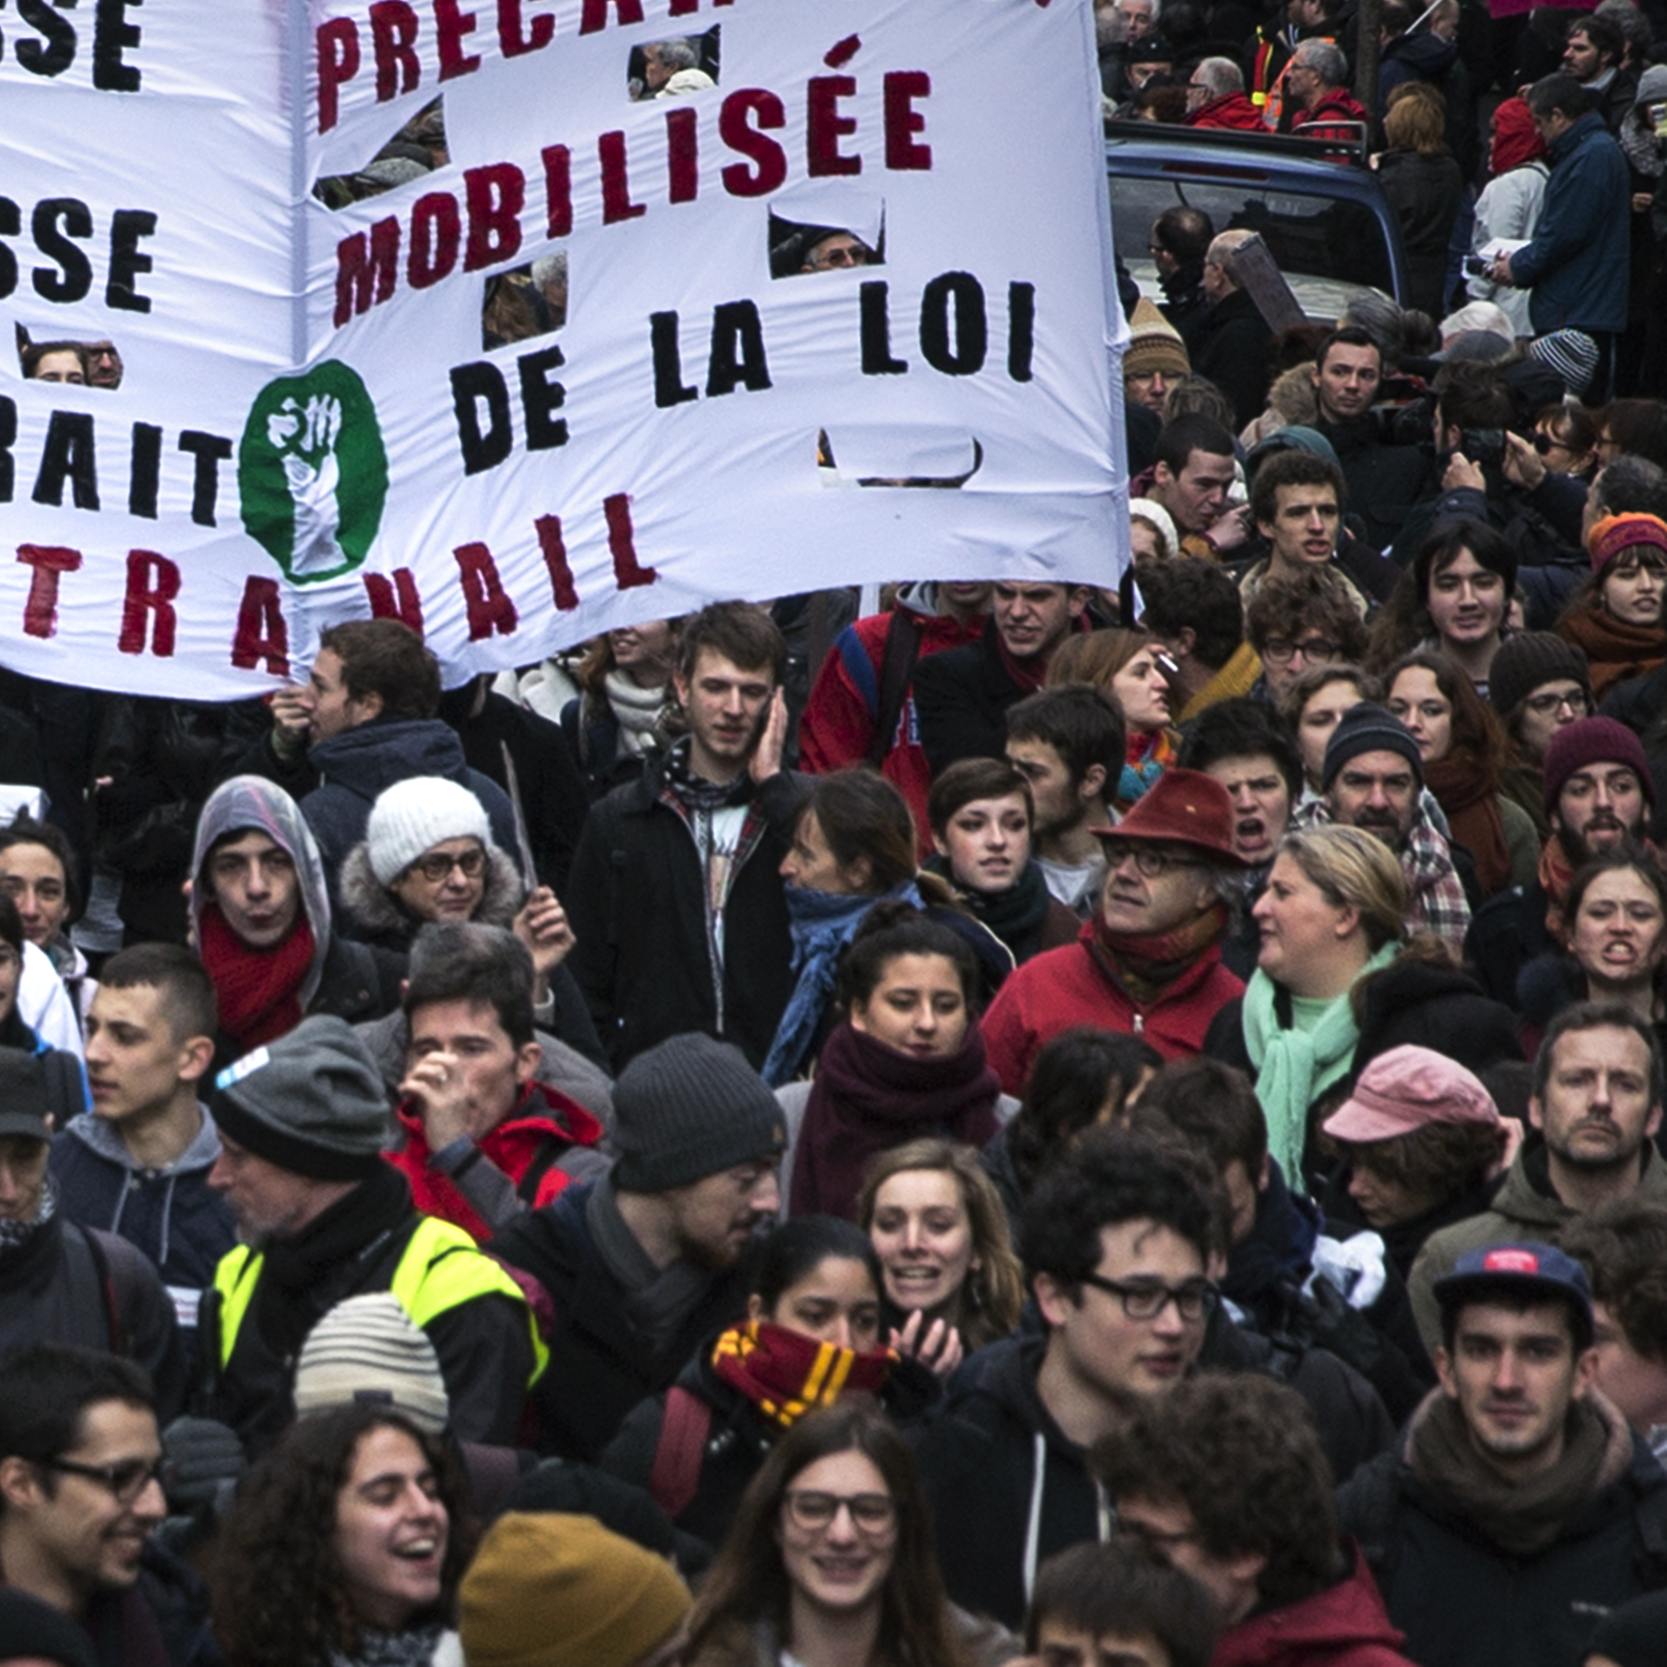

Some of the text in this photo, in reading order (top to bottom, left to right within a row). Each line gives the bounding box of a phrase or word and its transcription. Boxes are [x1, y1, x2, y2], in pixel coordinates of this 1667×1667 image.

[331, 34, 933, 329] MOBILISÉE
[448, 345, 570, 476] DE
[649, 297, 773, 408] LA
[859, 270, 1036, 384] LOI
